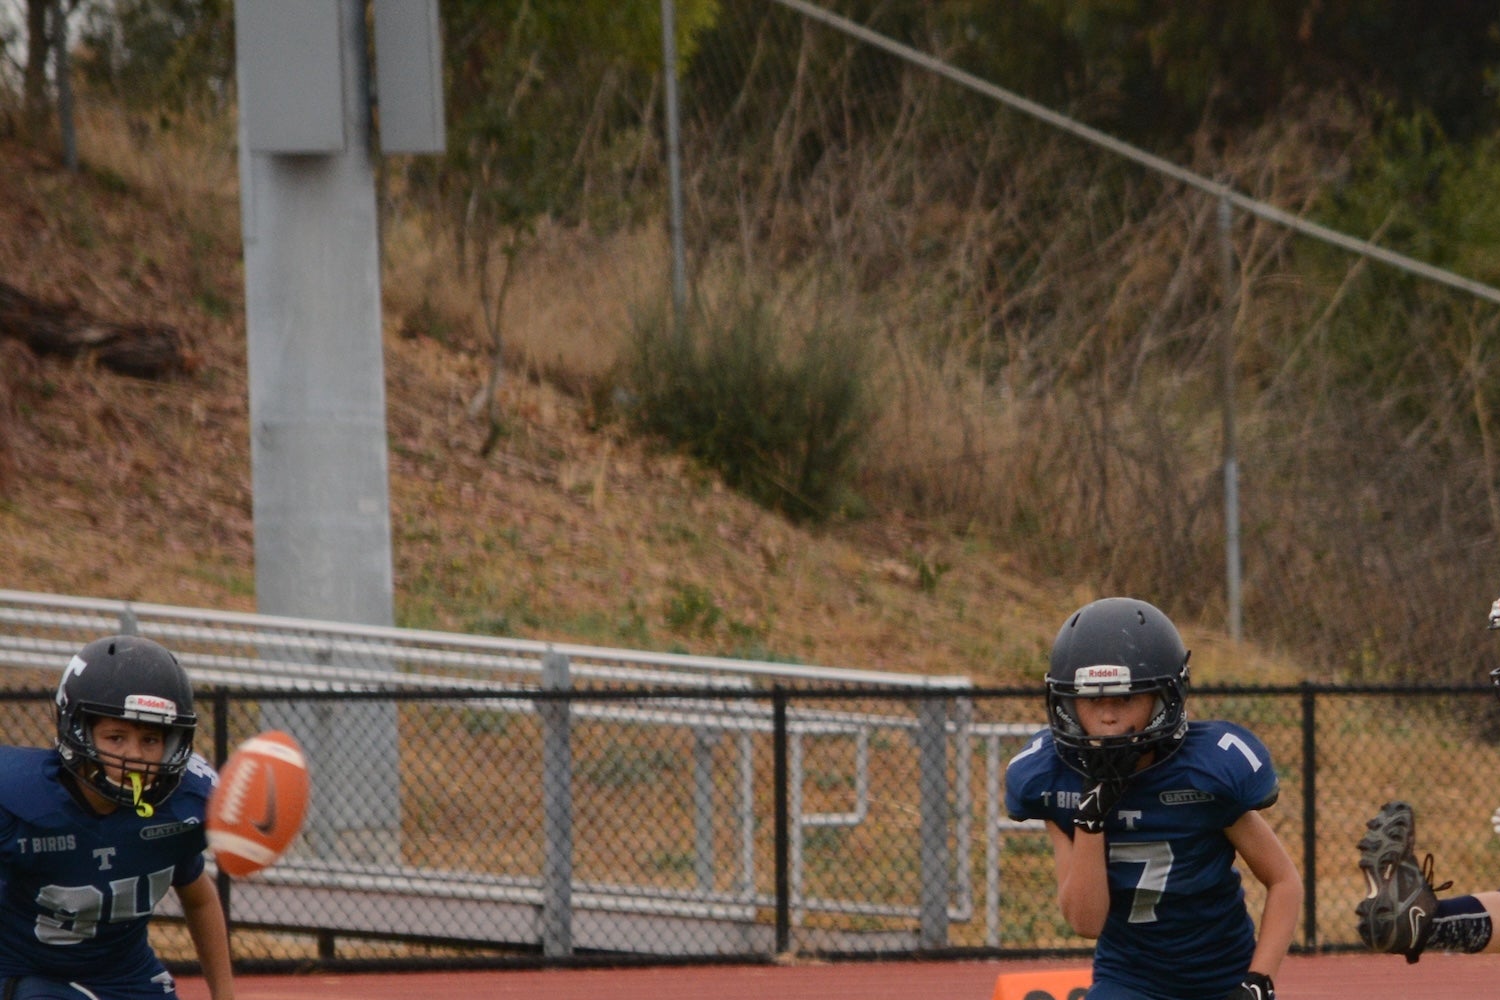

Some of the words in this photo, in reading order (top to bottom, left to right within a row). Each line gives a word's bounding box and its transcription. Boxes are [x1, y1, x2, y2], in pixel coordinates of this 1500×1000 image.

[1088, 668, 1118, 678] Riddell
[1217, 733, 1263, 773] 7
[1041, 791, 1052, 806] T
[1056, 790, 1082, 808] BIR
[1118, 810, 1142, 831] T
[17, 838, 28, 853] T
[32, 834, 76, 853] BIRDS
[92, 847, 116, 871] T
[1109, 841, 1174, 923] 7
